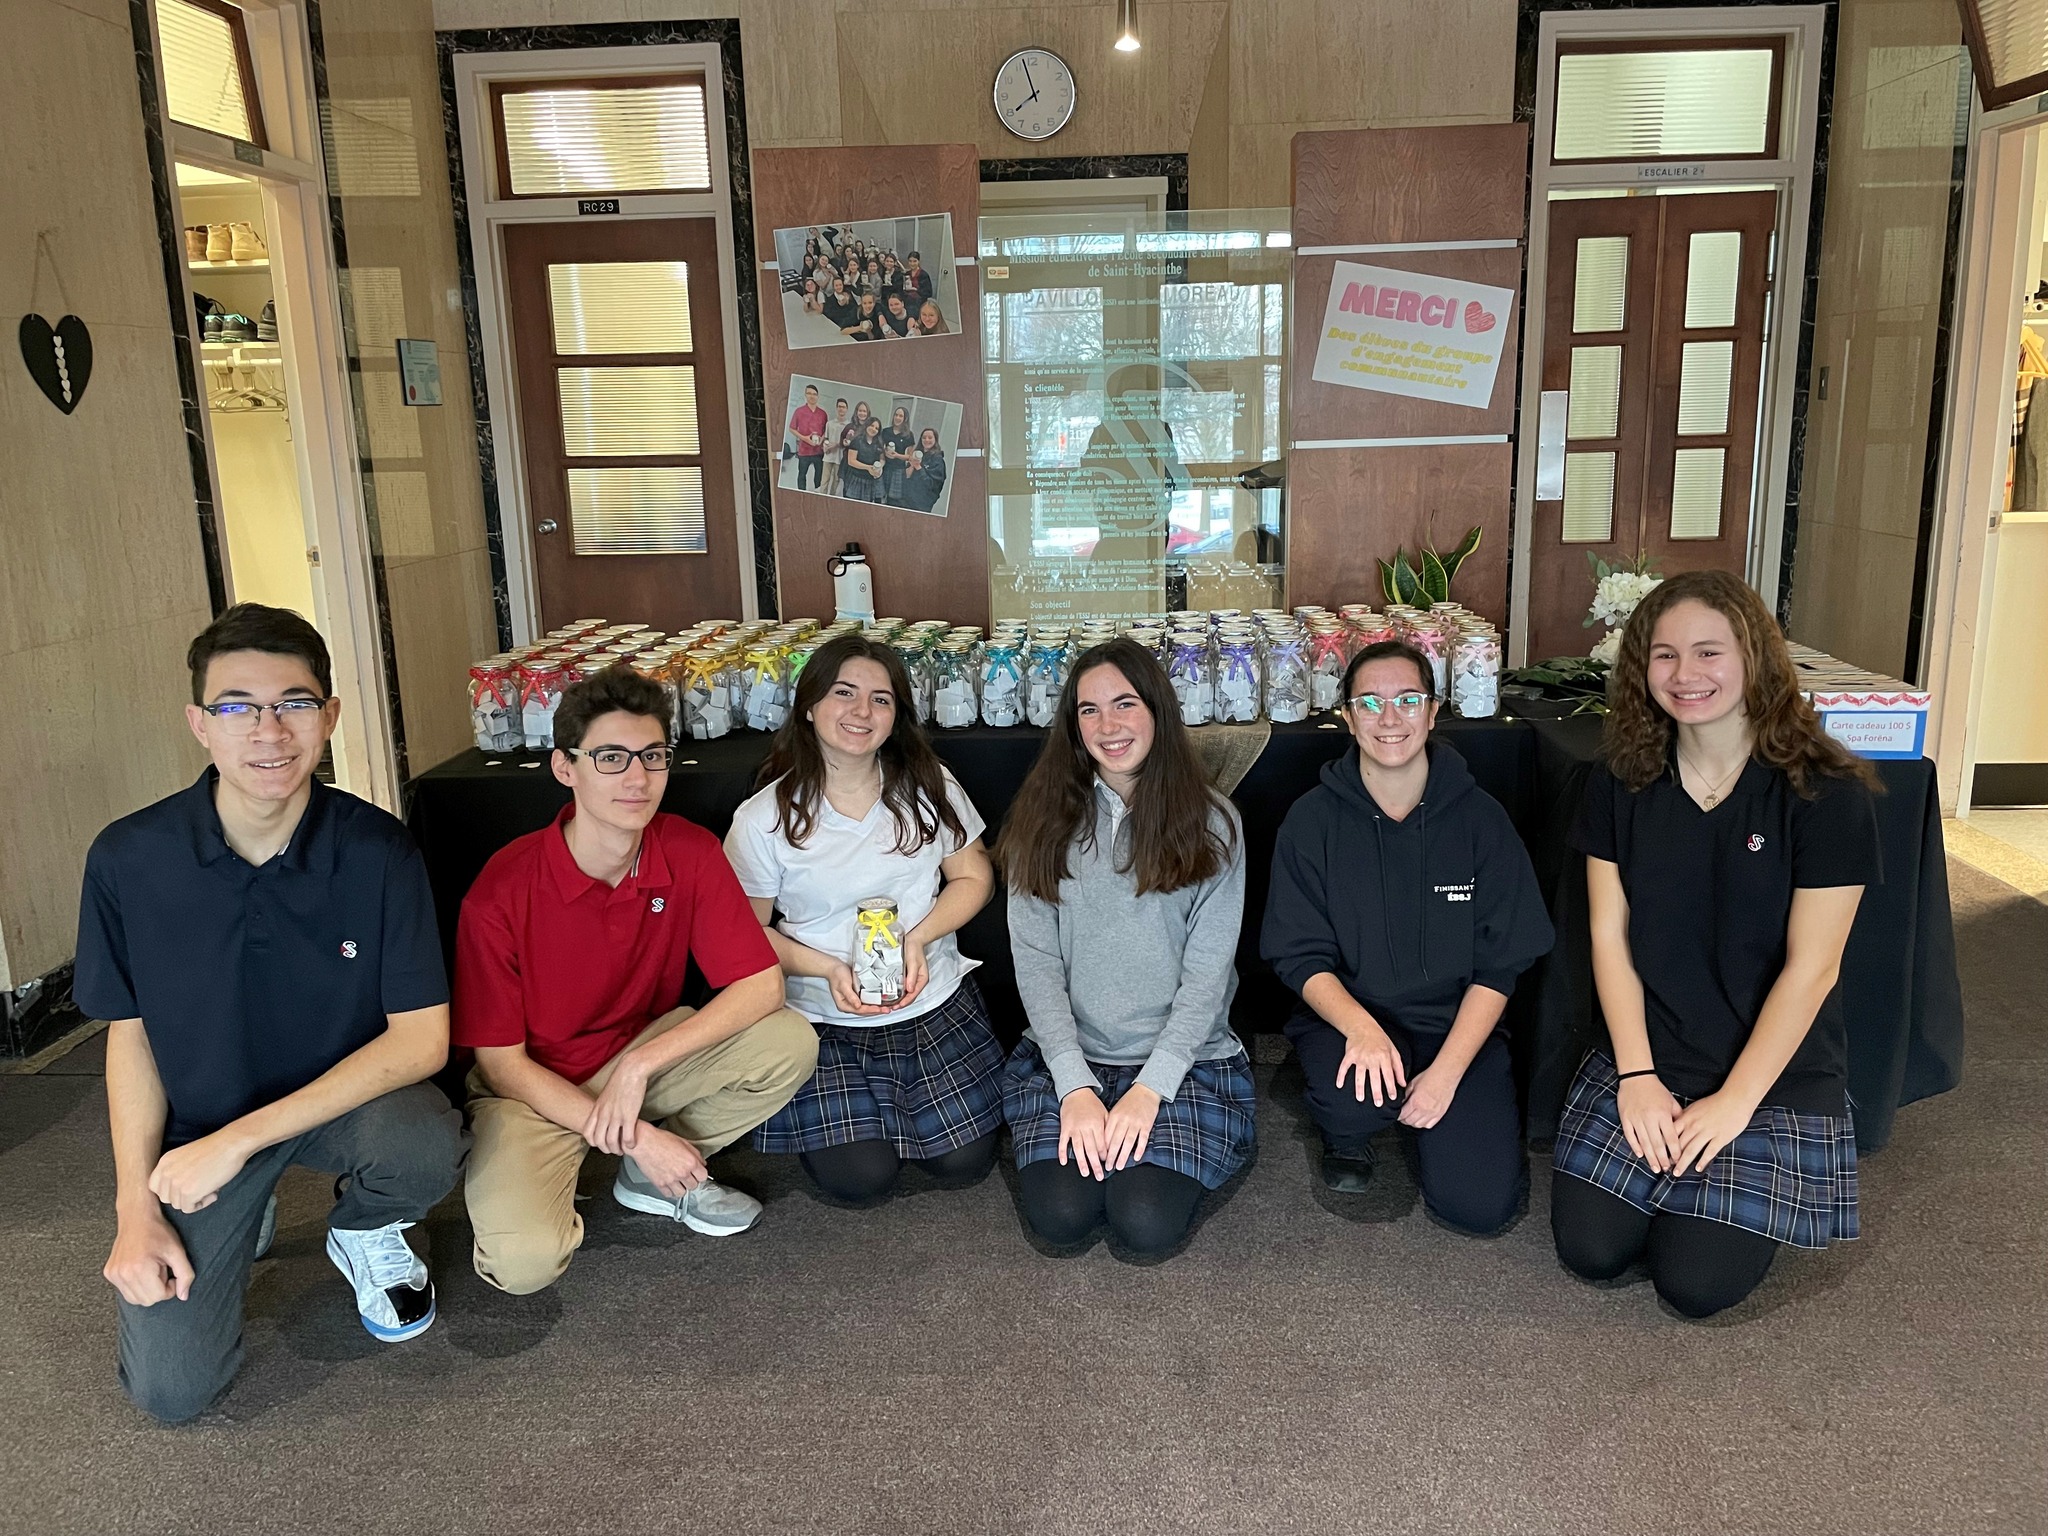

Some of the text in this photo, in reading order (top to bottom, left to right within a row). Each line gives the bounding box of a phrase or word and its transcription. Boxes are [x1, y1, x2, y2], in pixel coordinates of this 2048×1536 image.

[1645, 168, 1688, 177] ESCALIER
[1088, 261, 1182, 277] de Saint-Hyacinthe
[1023, 287, 1098, 308] PAVILLO
[1339, 282, 1460, 329] MERCI
[1327, 327, 1493, 364] Des élèves du groupe
[1351, 346, 1464, 374] d'engagement
[1030, 601, 1042, 609] Son
[1831, 722, 1911, 731] Carte cadeau 100 $
[1847, 734, 1861, 743] Spa
